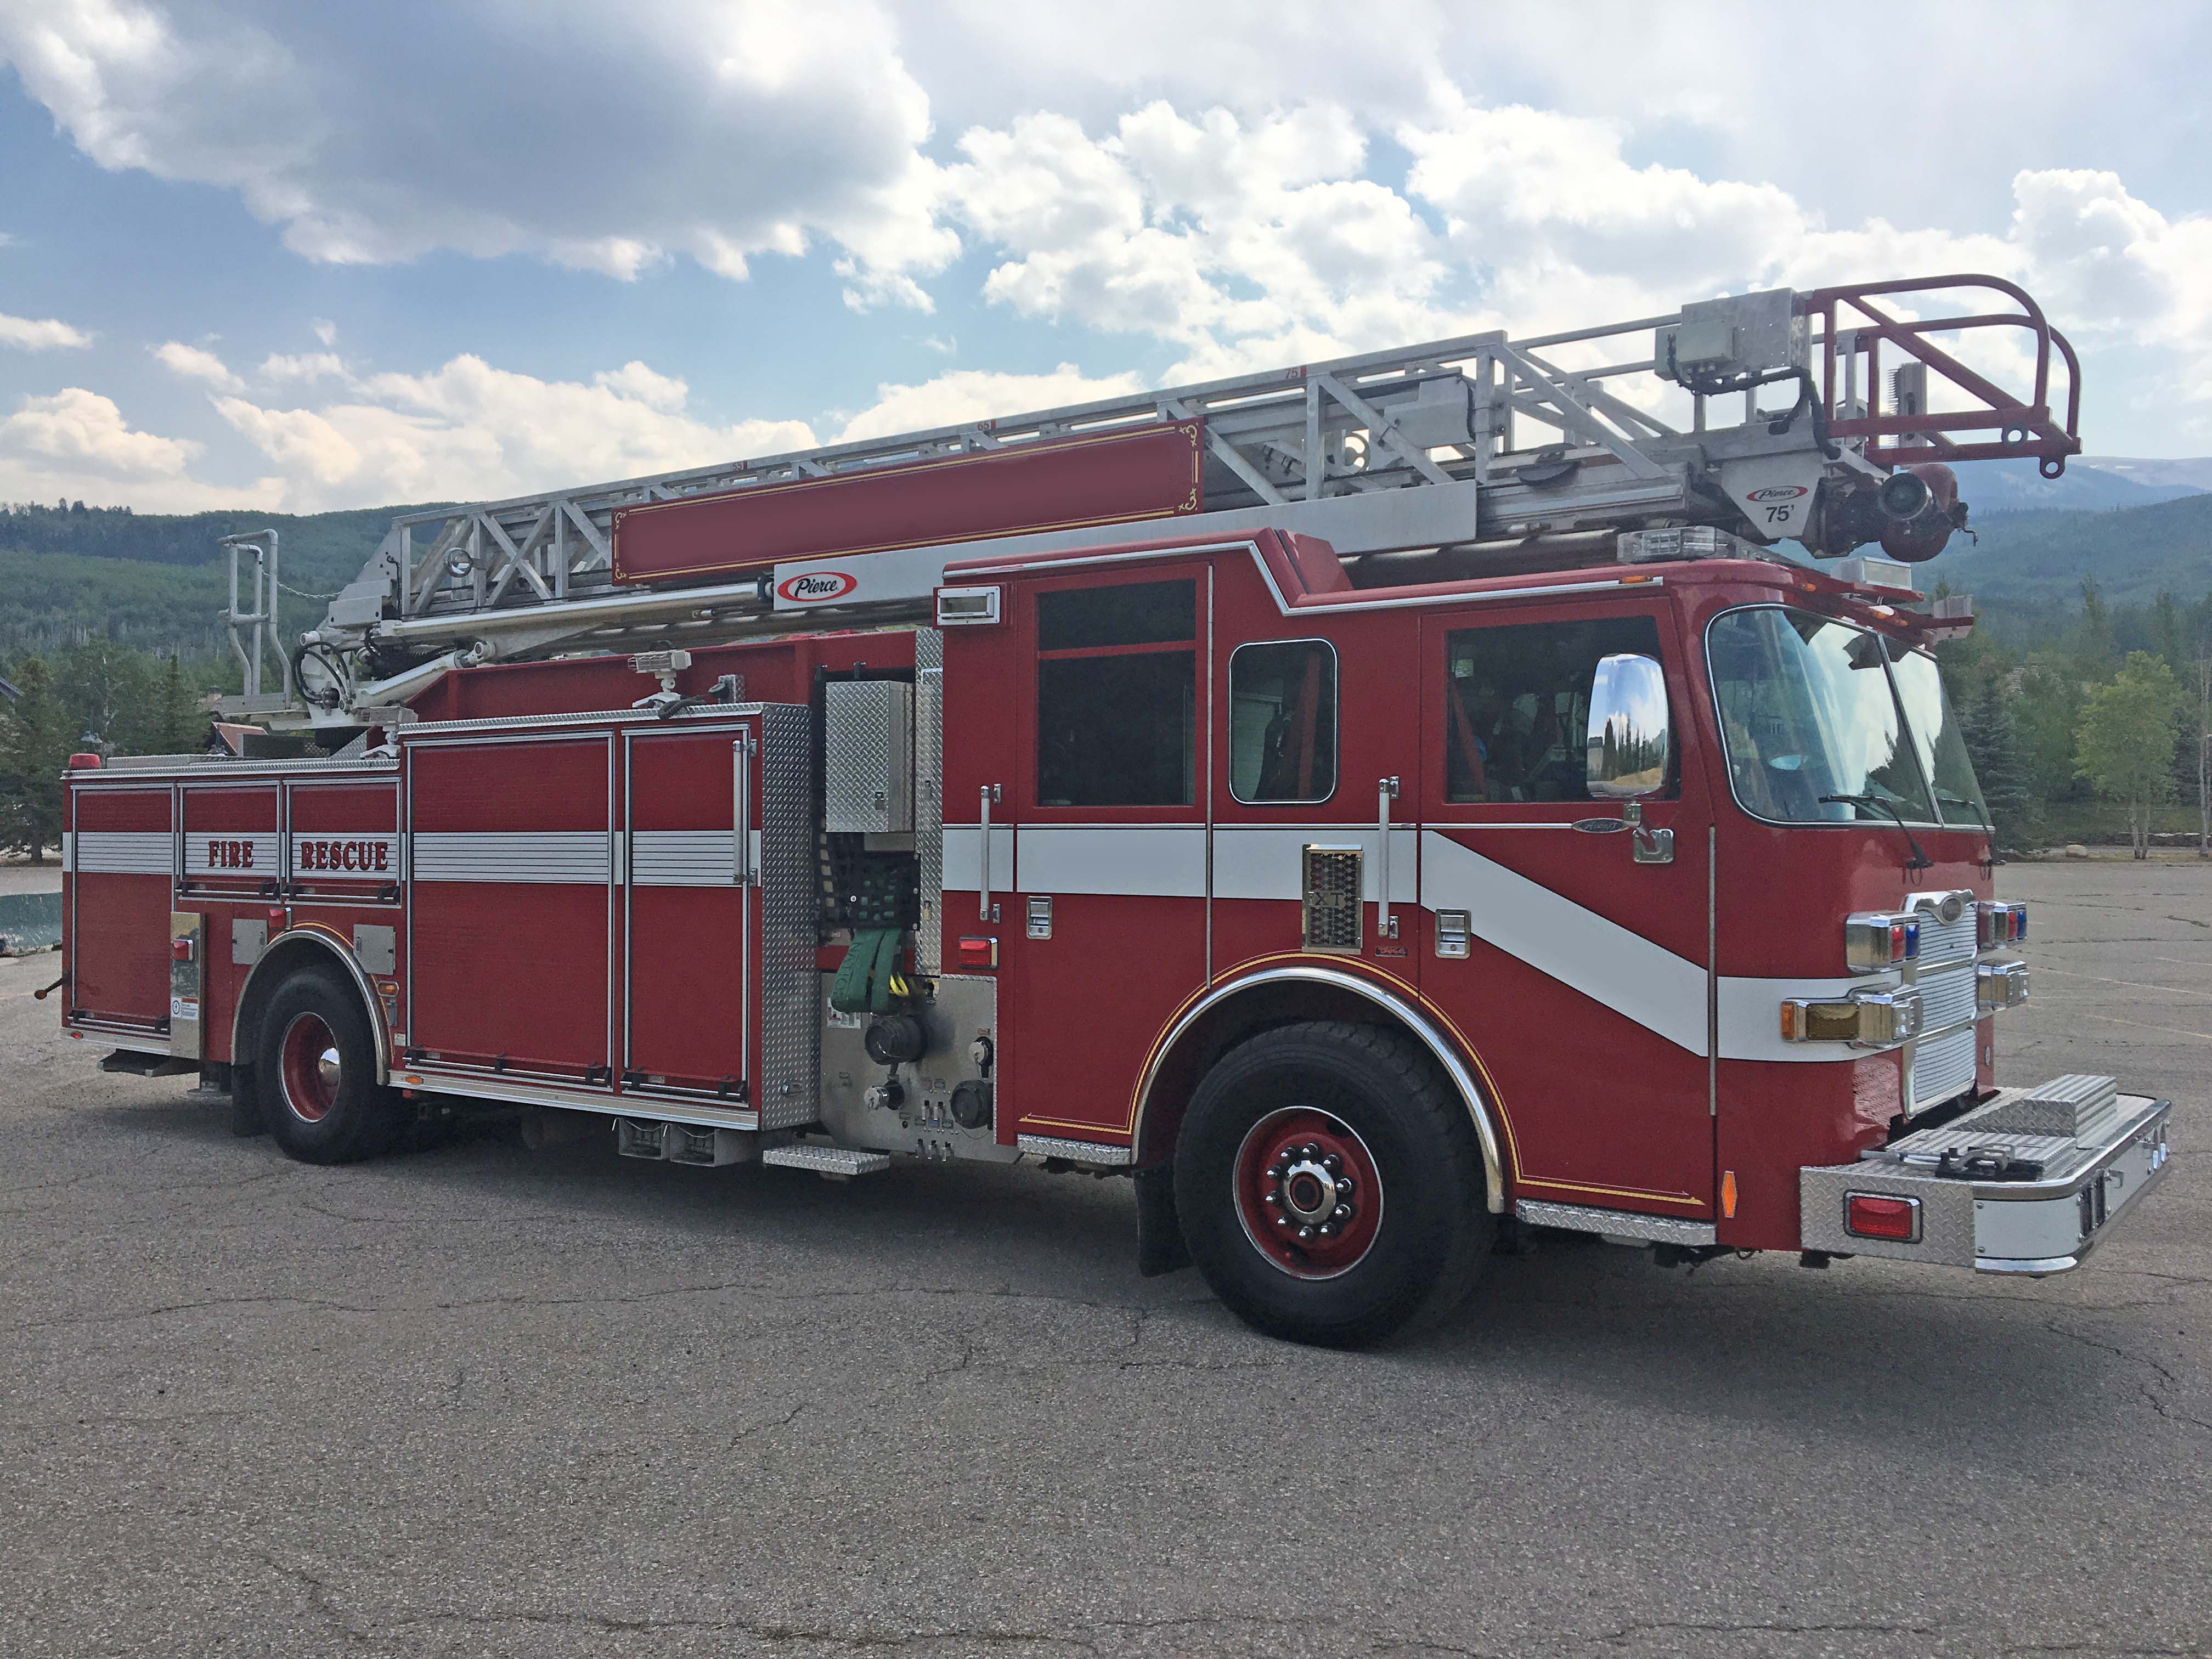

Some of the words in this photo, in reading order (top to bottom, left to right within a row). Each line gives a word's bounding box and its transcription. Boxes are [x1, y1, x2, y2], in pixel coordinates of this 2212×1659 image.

[1285, 367, 1299, 379] 75
[977, 420, 989, 431] 65
[732, 461, 742, 471] 55
[1758, 489, 1795, 499] Pierce
[1766, 505, 1795, 522] 75'
[794, 578, 838, 597] Pierce
[208, 840, 253, 868] FIRE
[301, 841, 388, 871] RESCUE
